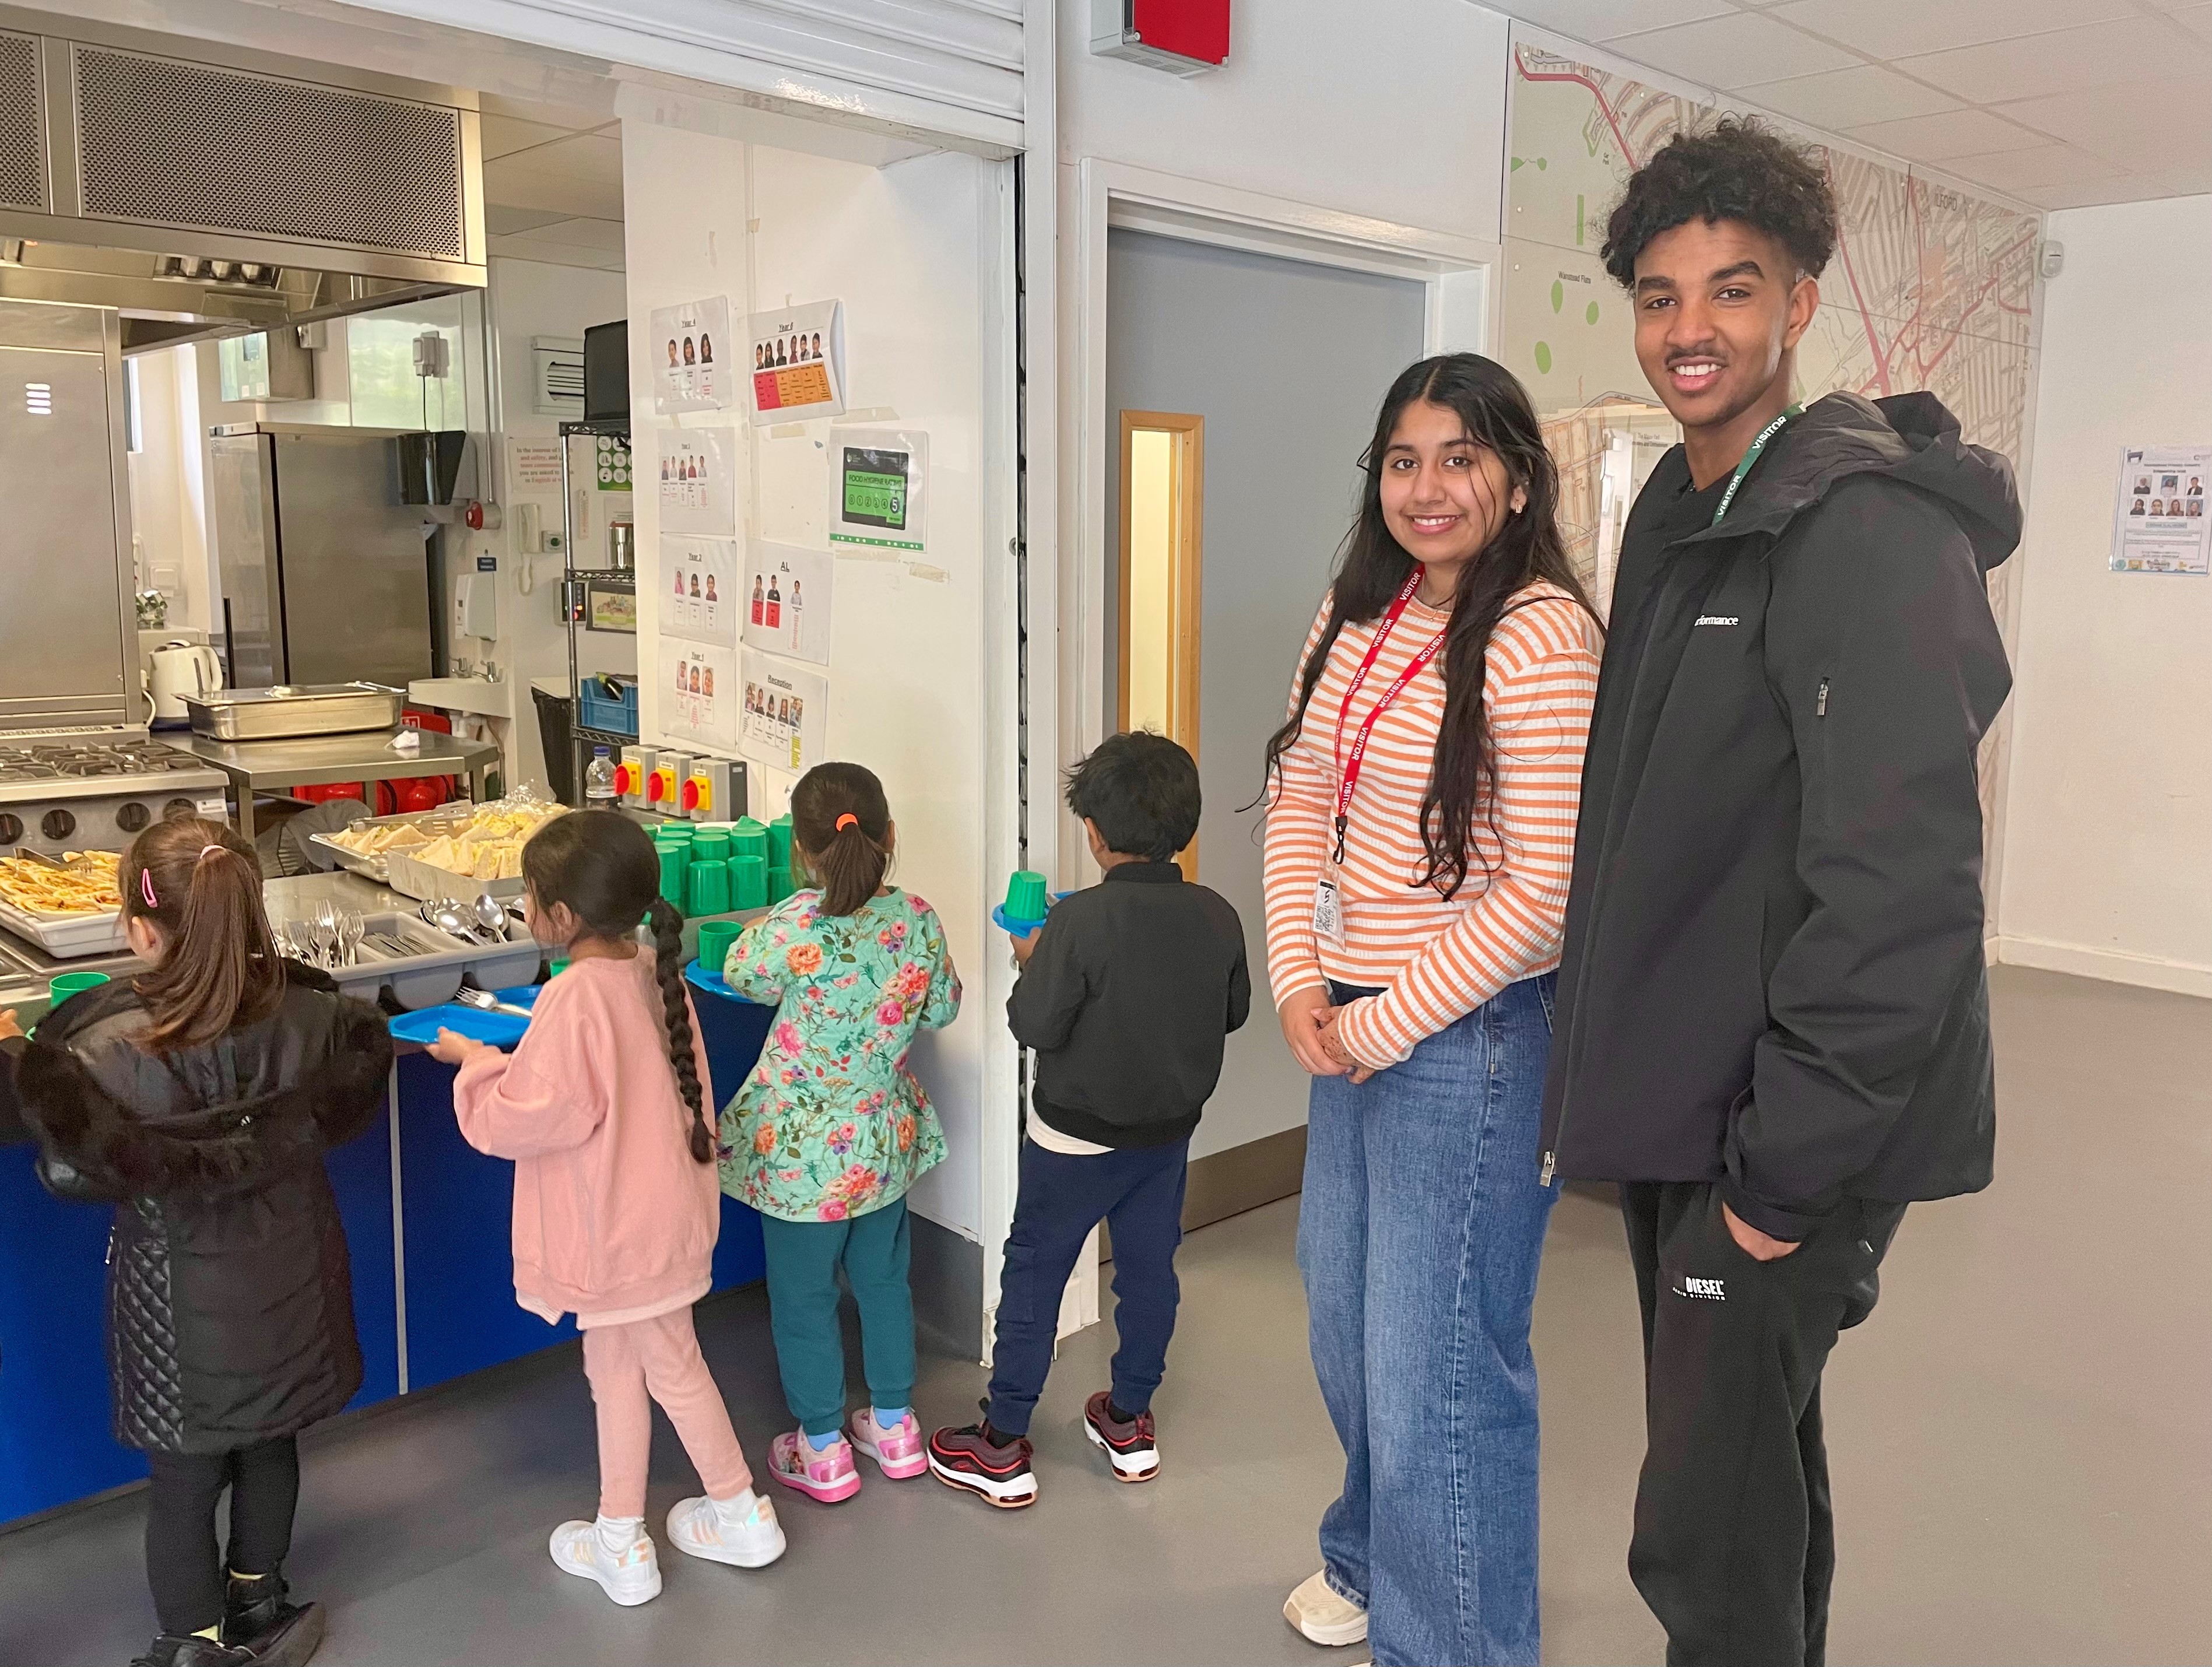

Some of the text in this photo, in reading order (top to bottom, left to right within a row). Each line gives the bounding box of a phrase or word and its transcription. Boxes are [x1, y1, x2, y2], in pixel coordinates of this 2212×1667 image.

[682, 320, 692, 328] Year
[778, 324, 789, 332] Year
[1751, 416, 1787, 450] VISITOR
[848, 475, 863, 483] FOOD
[863, 476, 884, 485] HYGIENE
[892, 499, 898, 512] 5
[1717, 474, 1741, 516] VISITOR
[688, 553, 698, 561] Year
[781, 561, 789, 571] AL
[1399, 572, 1421, 601] VISITOR
[1371, 618, 1393, 648] VISITOR
[691, 652, 700, 661] Year
[1417, 634, 1446, 662] VISITOR
[768, 675, 792, 690] Reception
[1346, 666, 1367, 697] VISITOR
[1378, 679, 1406, 708] VISITOR
[1351, 728, 1368, 761] VISITOR
